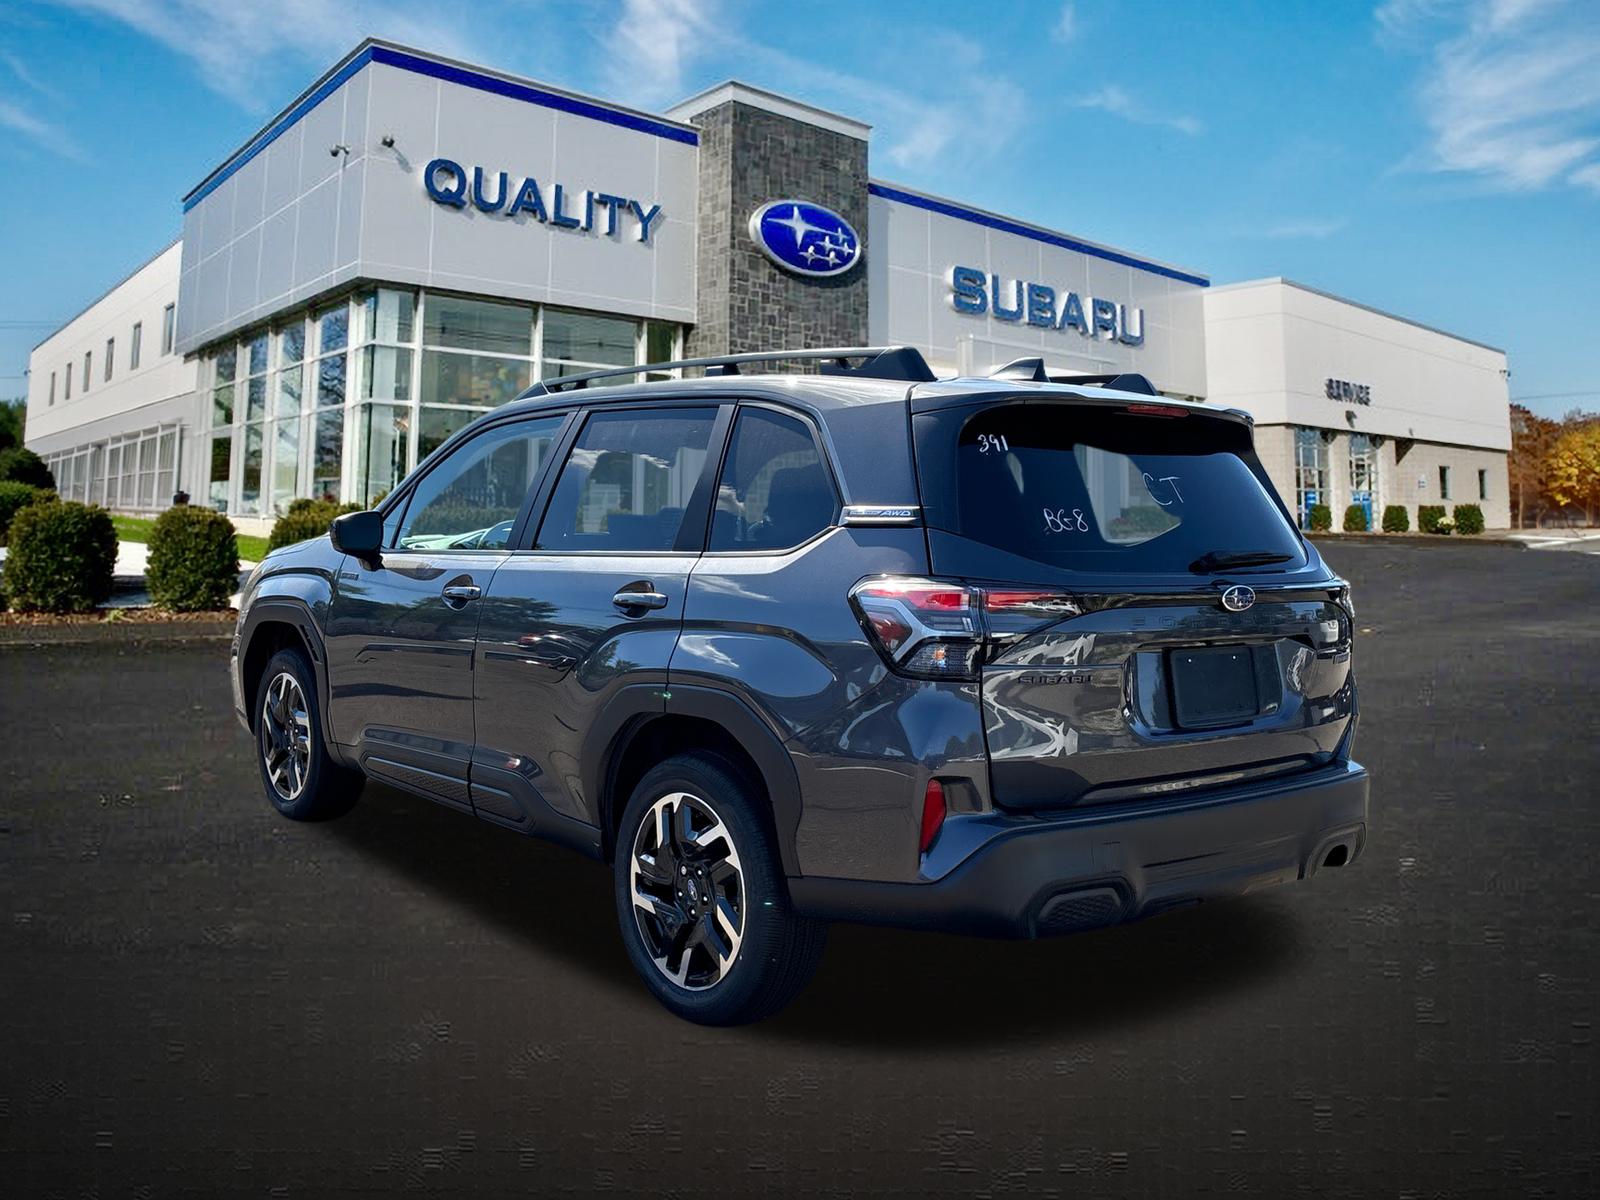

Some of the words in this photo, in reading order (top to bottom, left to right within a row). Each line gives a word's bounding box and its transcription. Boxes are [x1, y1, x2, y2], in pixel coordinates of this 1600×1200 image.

[424, 158, 661, 242] QUALITY
[951, 265, 1145, 345] SUBARU
[1325, 378, 1371, 406] SERVICE
[977, 434, 1009, 453] 391
[1142, 472, 1185, 506] CT
[1018, 674, 1092, 684] SUBARU
